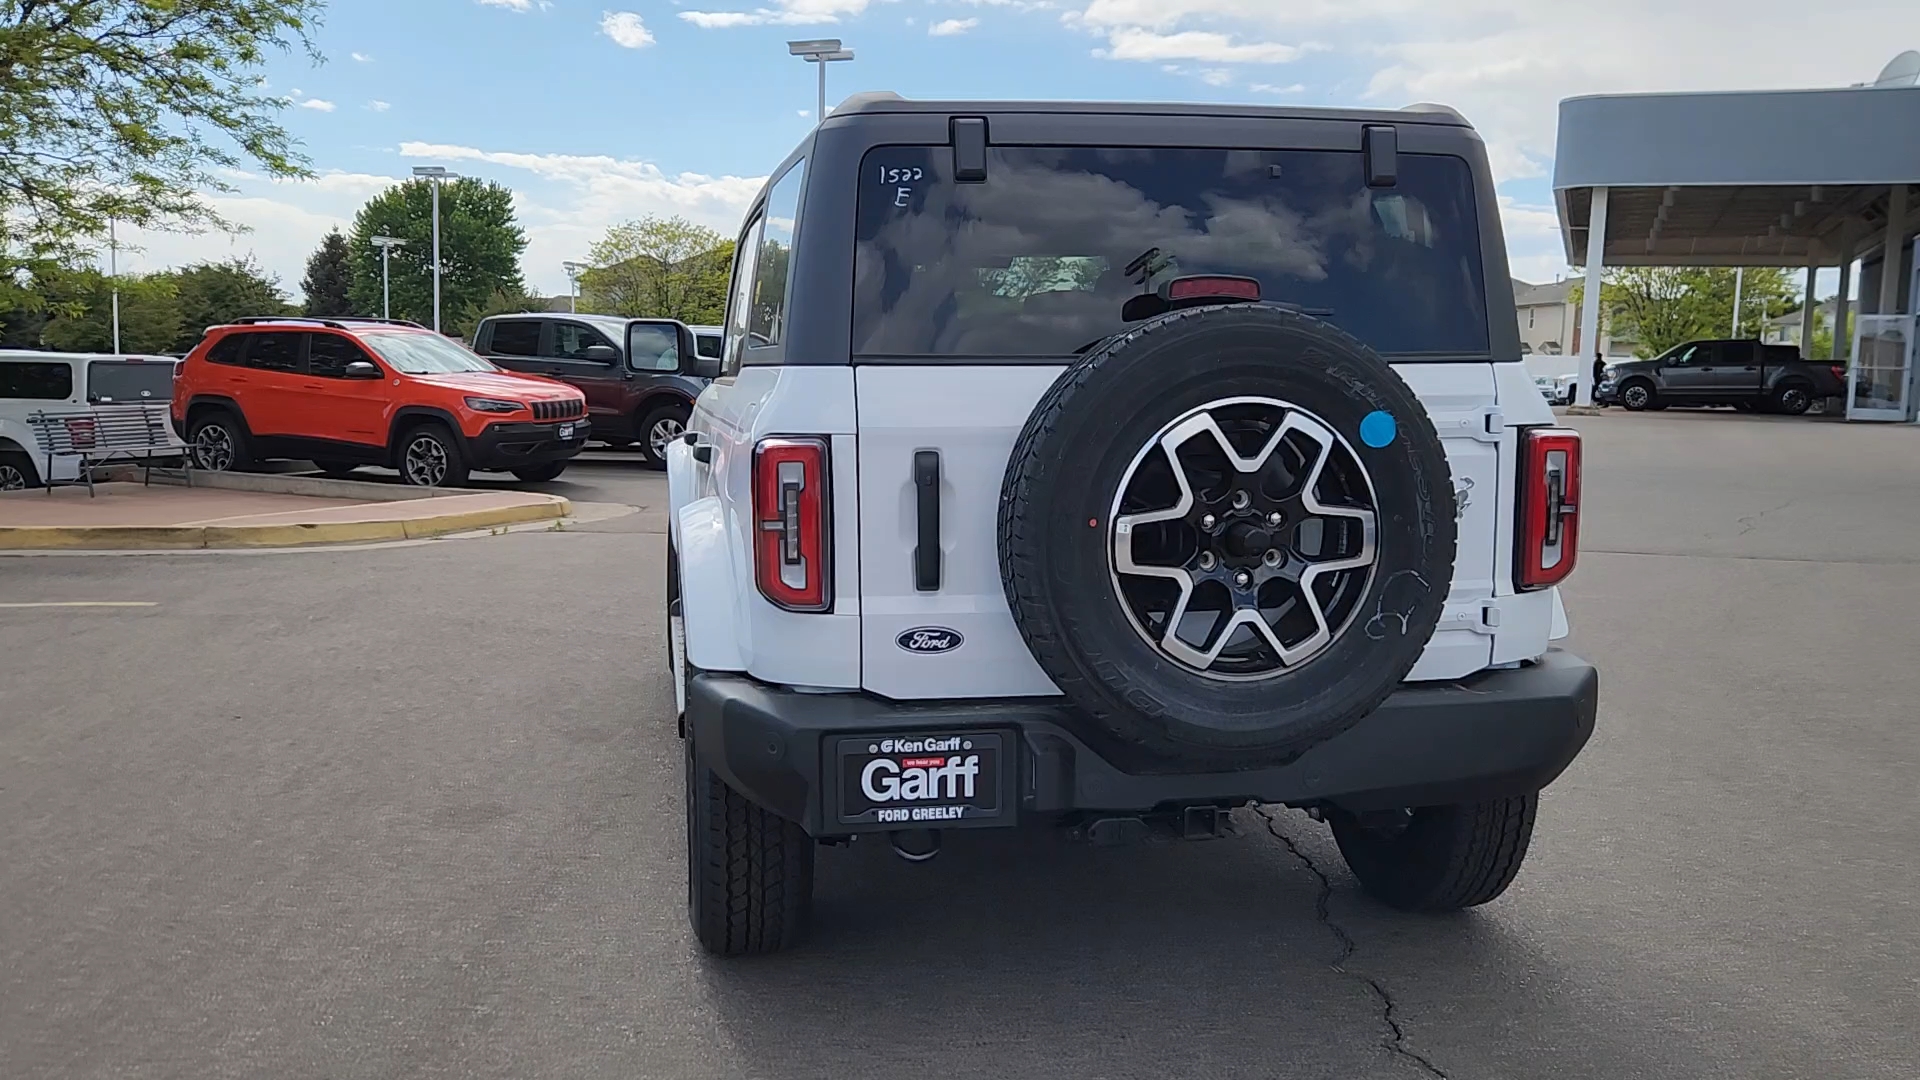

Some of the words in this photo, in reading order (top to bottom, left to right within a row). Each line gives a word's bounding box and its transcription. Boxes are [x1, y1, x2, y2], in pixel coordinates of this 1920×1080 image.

[894, 187, 912, 207] E
[909, 631, 951, 649] Ford
[894, 738, 923, 753] Ken
[924, 737, 961, 752] Garff
[861, 755, 978, 802] Garff
[878, 809, 909, 822] FORD
[911, 807, 964, 820] GREELEY
